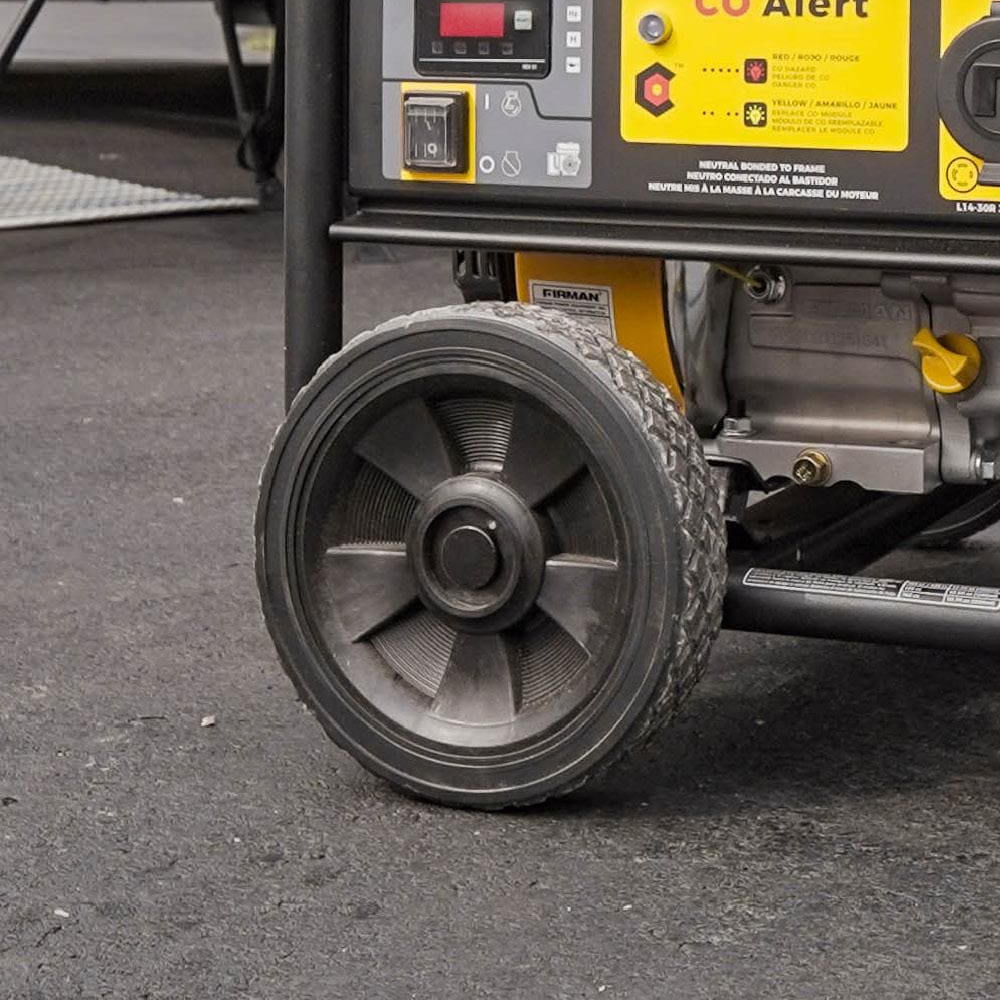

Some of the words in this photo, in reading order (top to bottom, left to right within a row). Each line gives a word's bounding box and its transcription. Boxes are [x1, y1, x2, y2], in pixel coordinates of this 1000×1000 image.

[772, 53, 790, 61] RED
[772, 99, 807, 108] YELLOW
[815, 101, 861, 109] AMARILLO
[868, 101, 898, 110] JAUNE
[699, 160, 739, 170] NEUTRAL
[741, 162, 778, 172] BONDED
[780, 163, 792, 172] TO
[793, 164, 826, 173] FRAME
[686, 171, 723, 181] NEUTRO
[724, 173, 778, 184] CONECTADO
[779, 175, 791, 184] AL
[792, 175, 839, 187] BASTIDOR
[648, 182, 683, 193] NEUTRE
[710, 185, 722, 194] LA
[723, 186, 753, 196] MASSE
[763, 187, 775, 196] LA
[776, 188, 824, 199] CARCASSE
[825, 190, 840, 199] DU
[841, 191, 879, 201] MOTEUR
[955, 202, 996, 213] L14-30R
[542, 288, 600, 302] FIRMAN
